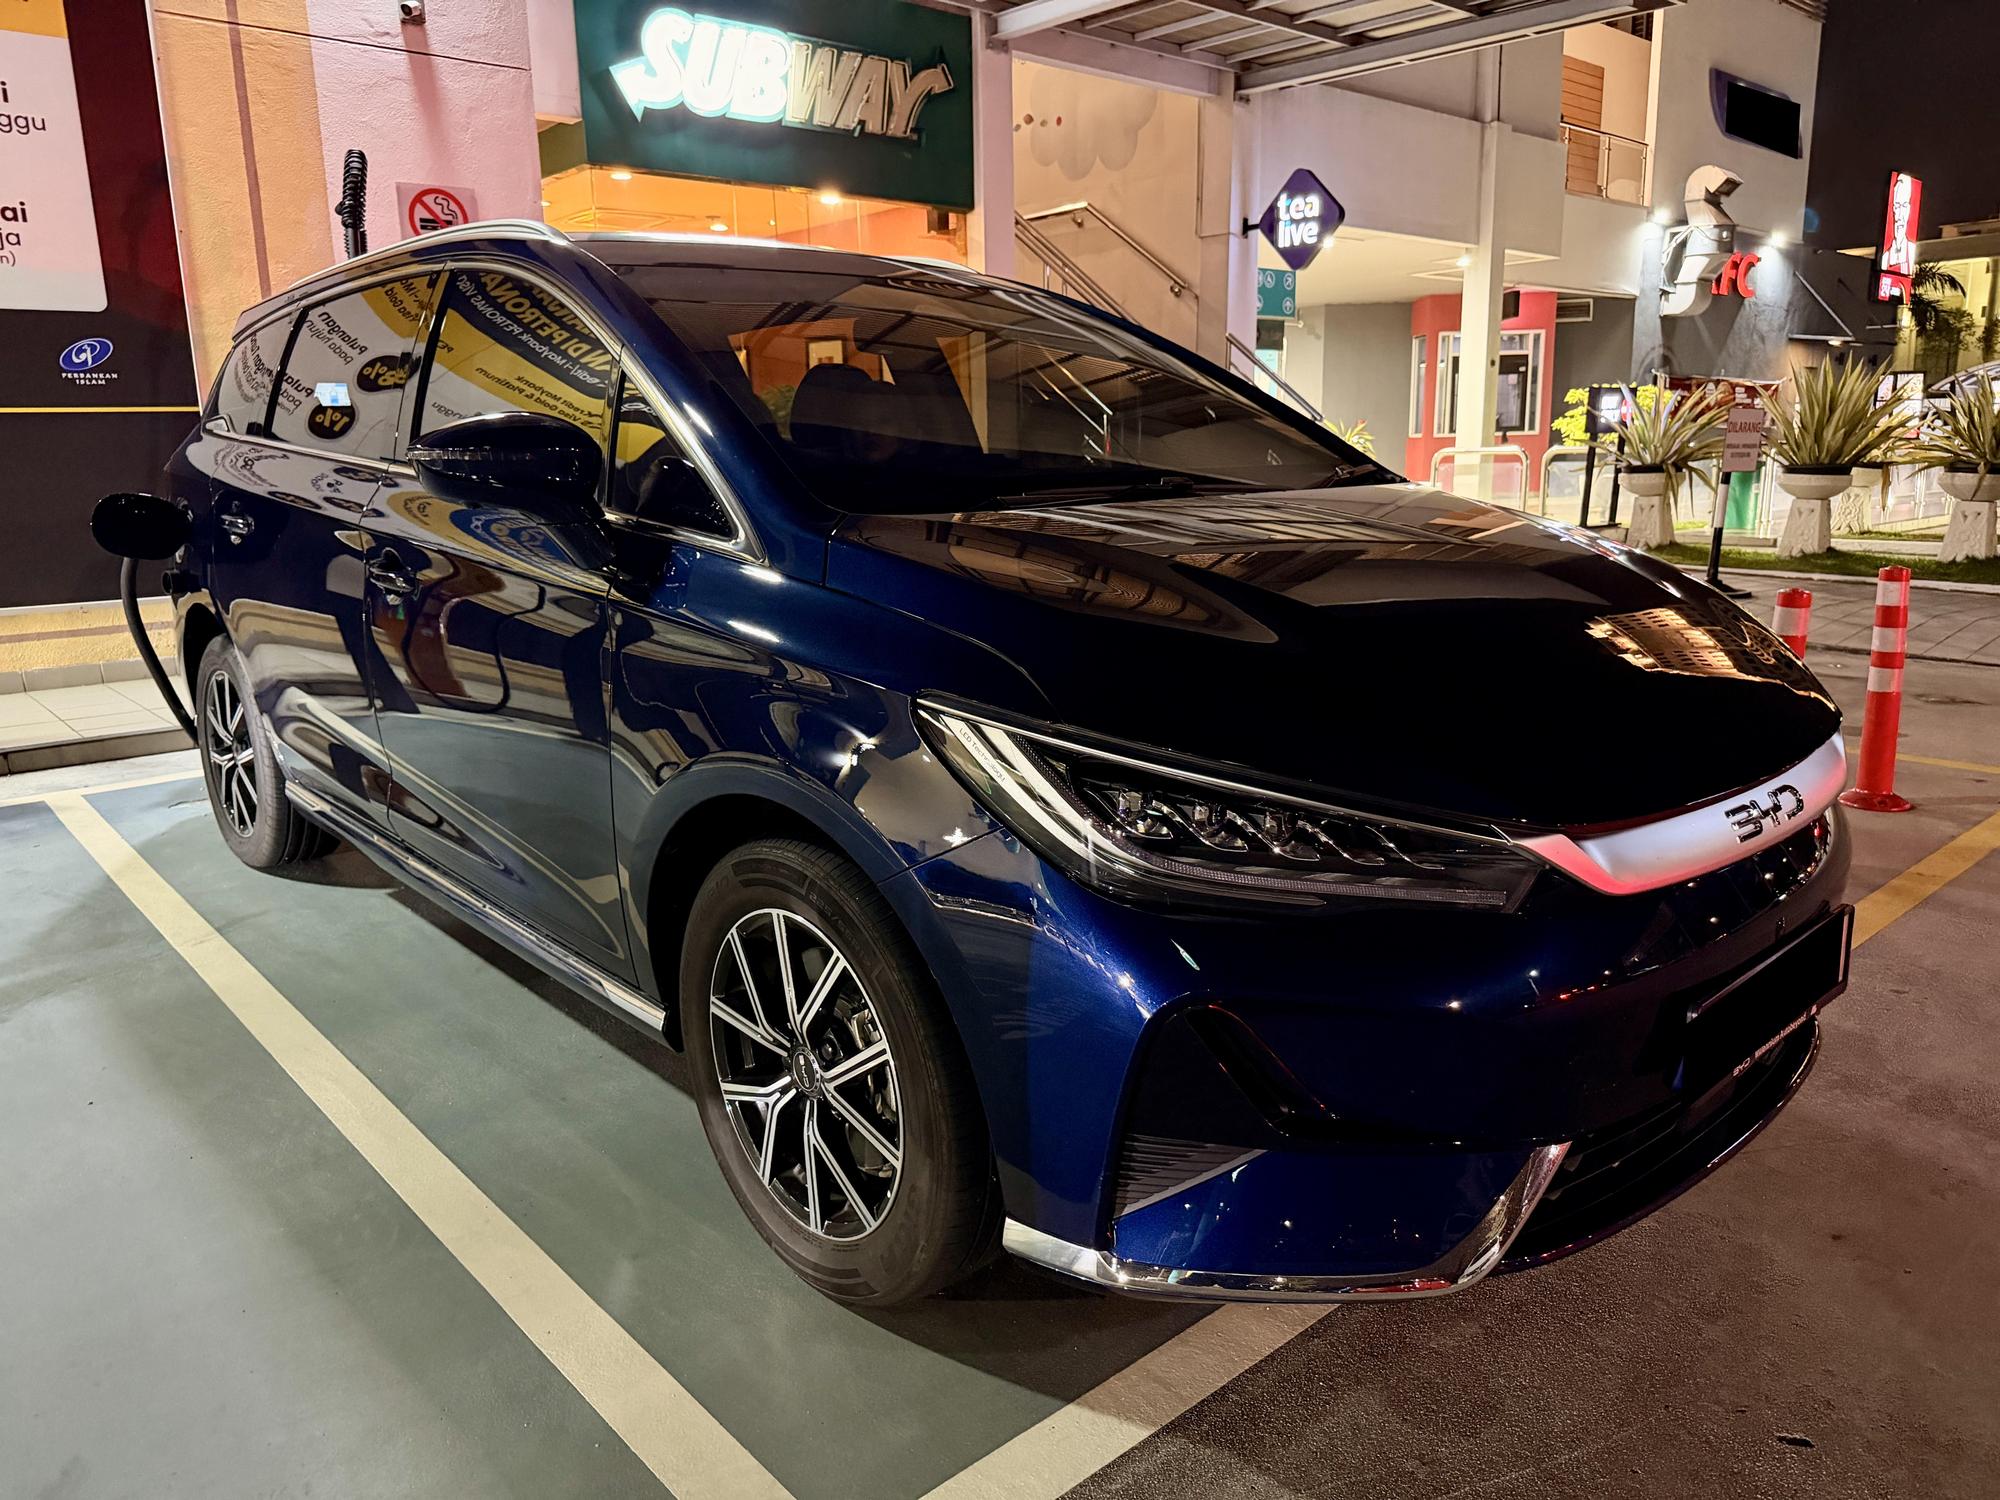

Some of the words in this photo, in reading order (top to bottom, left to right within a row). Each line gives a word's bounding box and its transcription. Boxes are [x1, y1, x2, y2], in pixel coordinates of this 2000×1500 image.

[609, 7, 953, 137] SUBWAY
[1277, 192, 1320, 220] tea
[1278, 220, 1319, 248] live
[1711, 251, 1759, 298] FC
[1725, 784, 1805, 844] BYD
